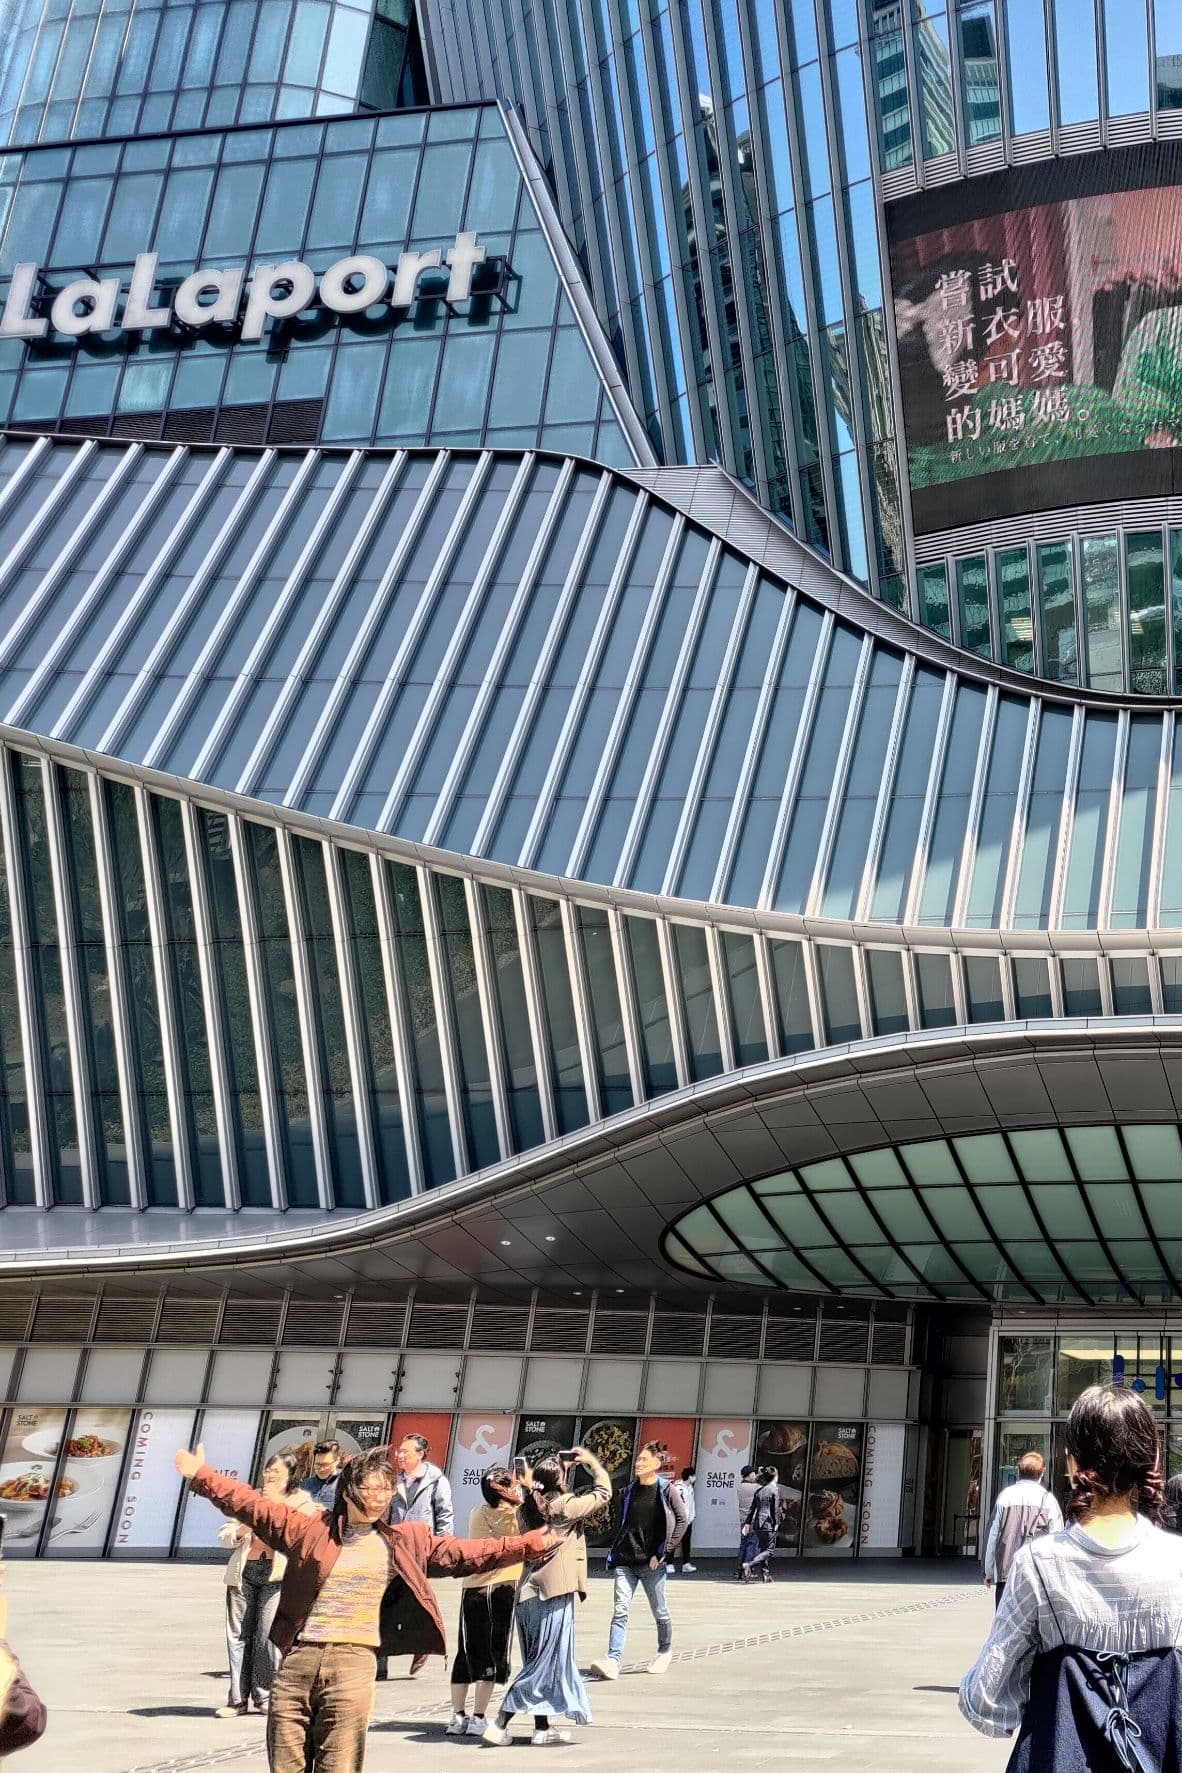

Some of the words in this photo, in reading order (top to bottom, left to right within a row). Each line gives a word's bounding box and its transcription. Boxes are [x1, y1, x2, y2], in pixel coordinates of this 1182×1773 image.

[0, 232, 486, 342] LaLaport
[934, 258, 1019, 311] 嘗試
[942, 340, 1069, 402] 變可愛
[128, 1411, 153, 1481] COMING
[864, 1425, 876, 1488] COMING
[706, 1480, 735, 1488] STONE
[707, 1472, 727, 1480] SALT
[118, 1496, 138, 1544] SOON
[860, 1501, 872, 1544] SOON
